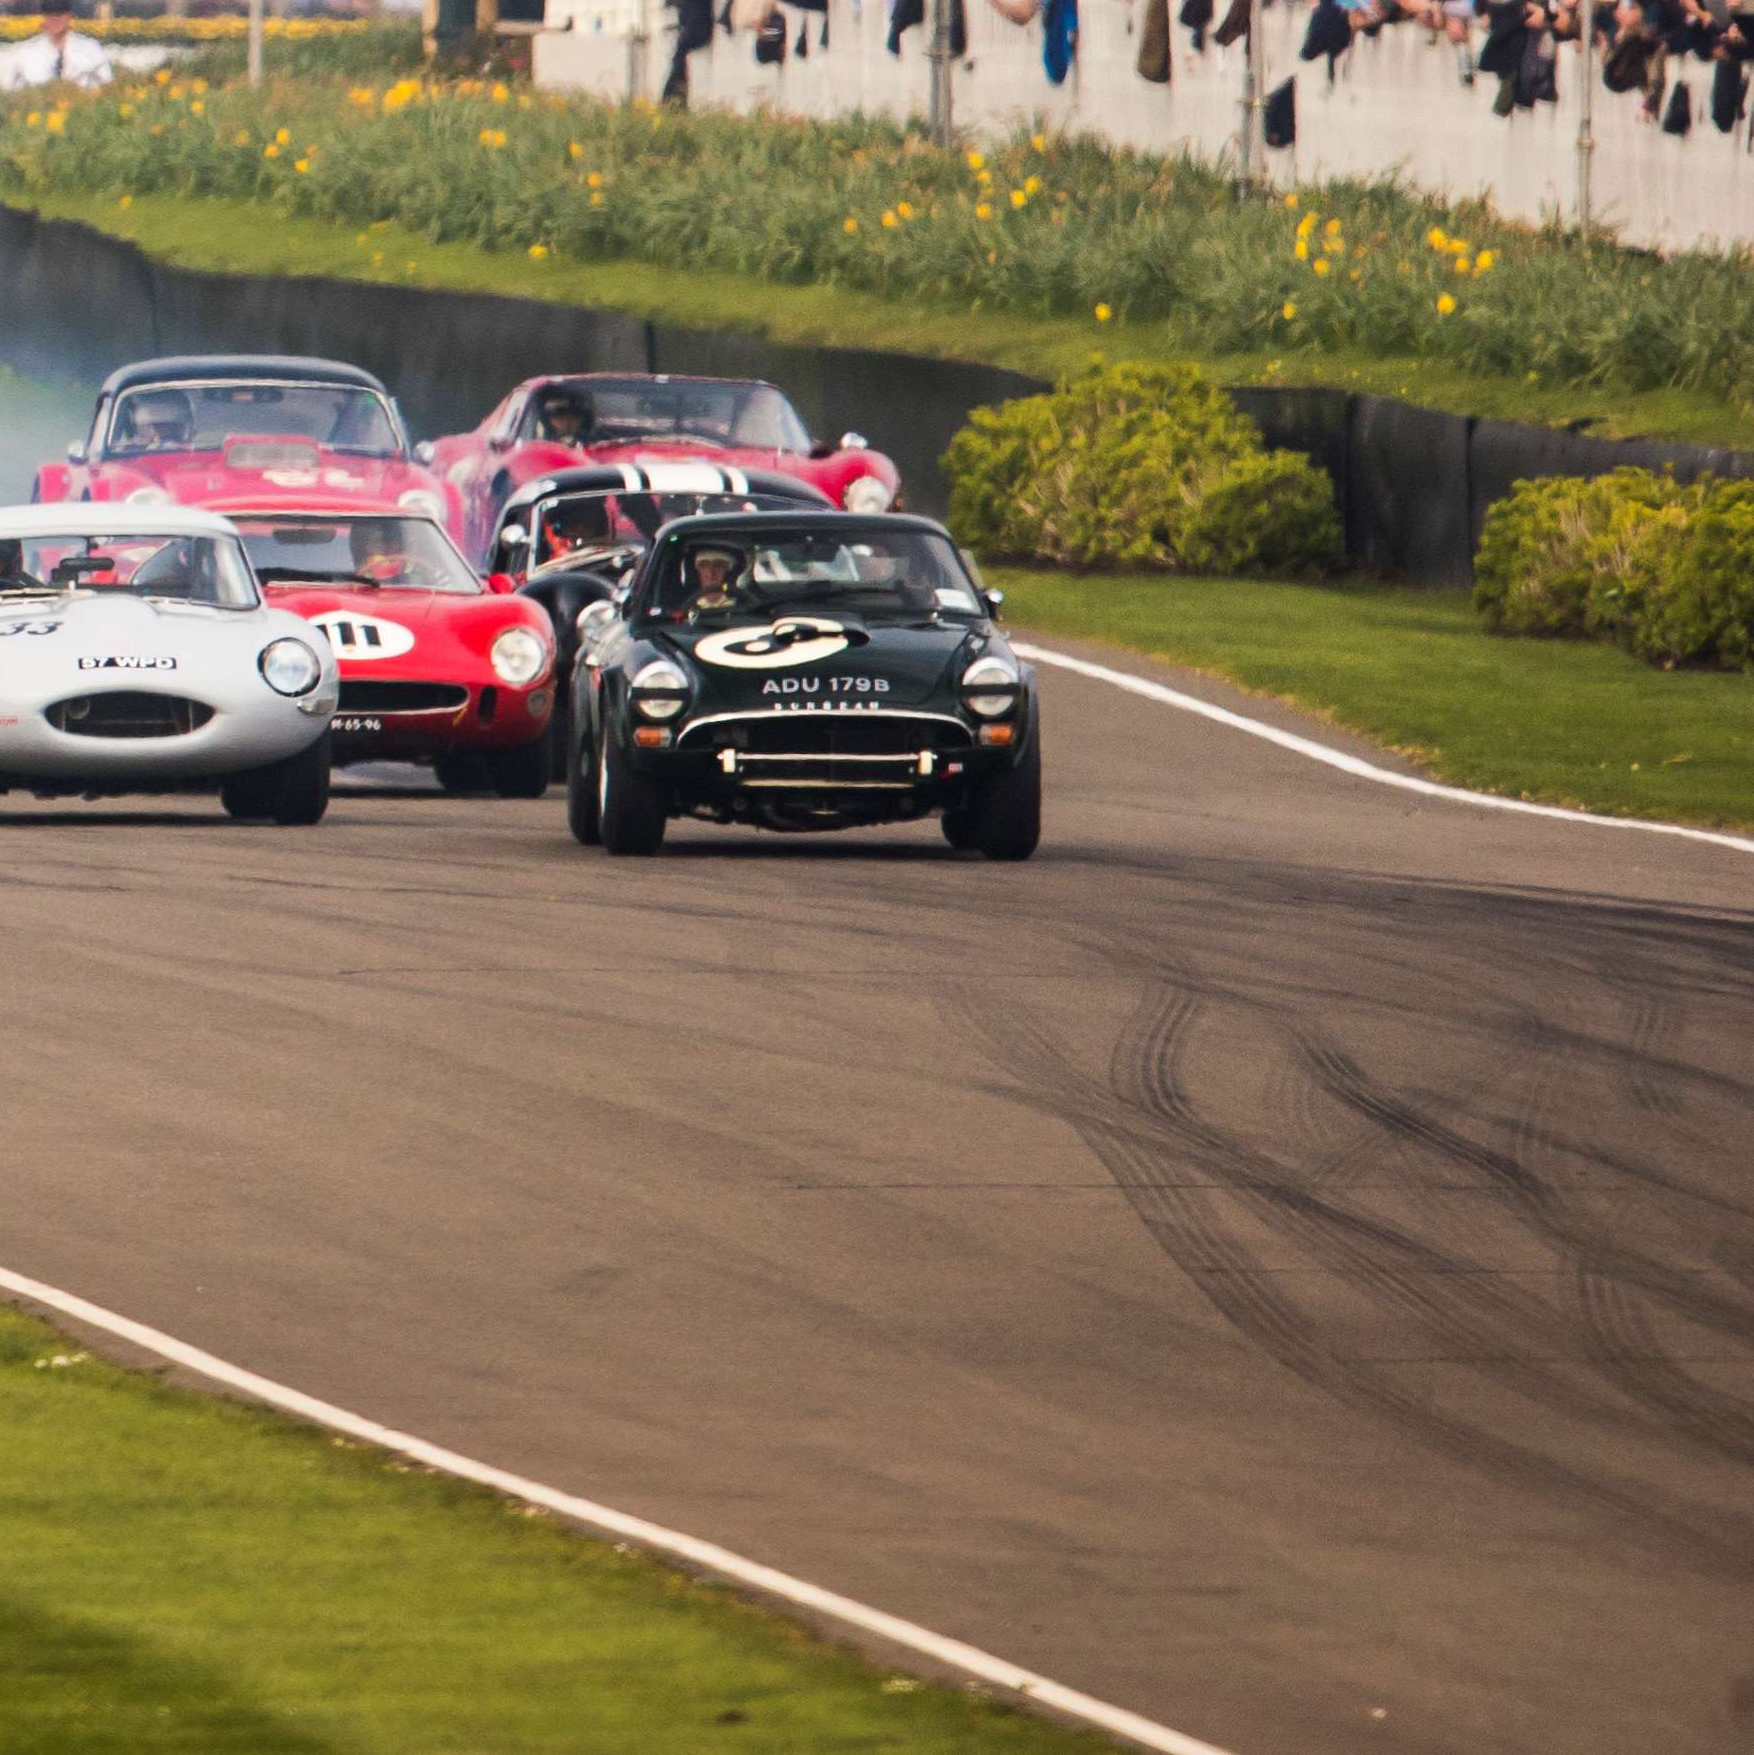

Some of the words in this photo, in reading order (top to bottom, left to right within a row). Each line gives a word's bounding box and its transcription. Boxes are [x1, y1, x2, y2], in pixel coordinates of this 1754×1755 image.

[113, 656, 174, 670] WPD
[762, 677, 820, 694] ADU
[829, 676, 890, 693] 179B
